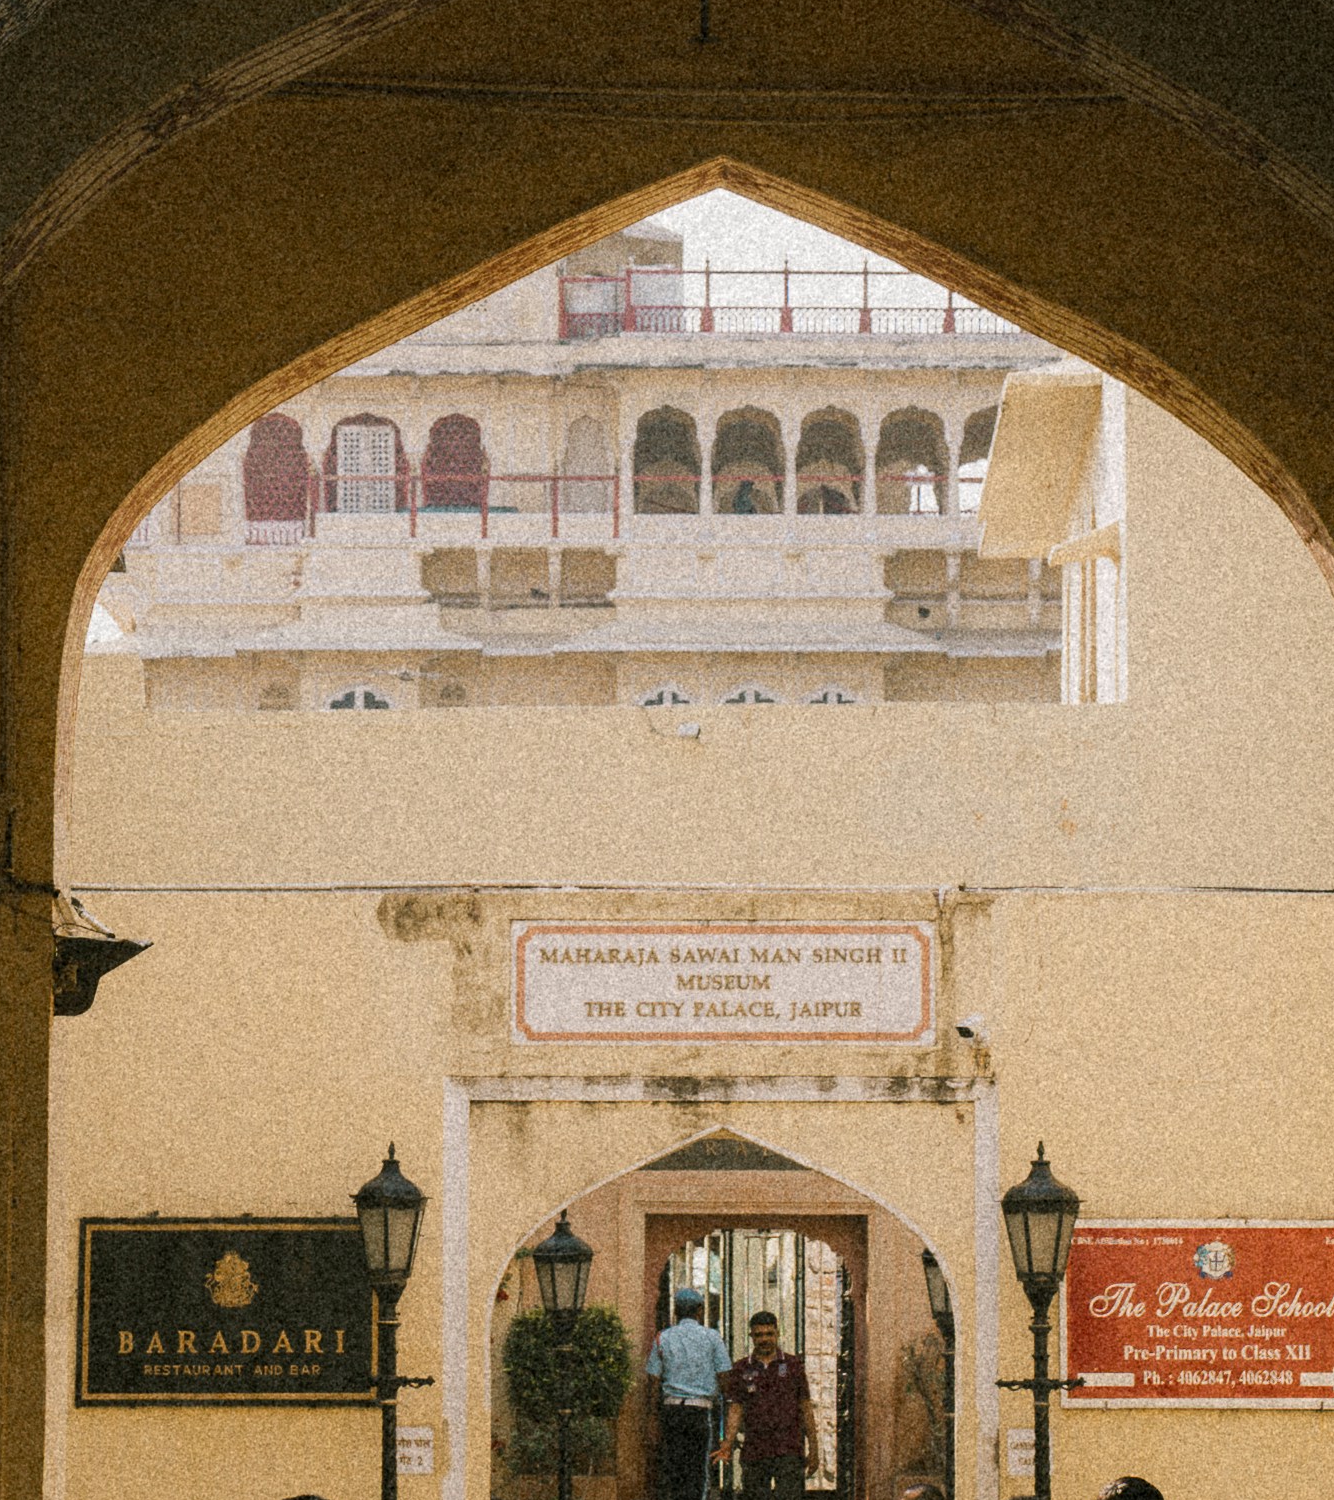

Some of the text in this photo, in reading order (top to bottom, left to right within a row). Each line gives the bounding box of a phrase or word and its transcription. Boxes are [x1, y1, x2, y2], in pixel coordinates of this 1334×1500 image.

[539, 948, 907, 966] MAHARAJA SAWAI MAN SINGH II
[676, 975, 771, 990] MUSEUM
[584, 1002, 862, 1020] THE CITY PALACE, JAIPUR
[1089, 1282, 1146, 1317] The
[1156, 1281, 1243, 1317] Palace
[1147, 1324, 1170, 1337] The
[1173, 1324, 1197, 1340] City
[1248, 1324, 1287, 1340] Jaipur
[118, 1330, 345, 1353] BARADARI
[1124, 1345, 1311, 1364] Pre-Primary to Class XII
[144, 1364, 321, 1376] RESTAURANT AND BAR
[1143, 1370, 1165, 1385] Ph.
[1177, 1370, 1236, 1388] 4062847,
[1239, 1370, 1293, 1385] 4062848
